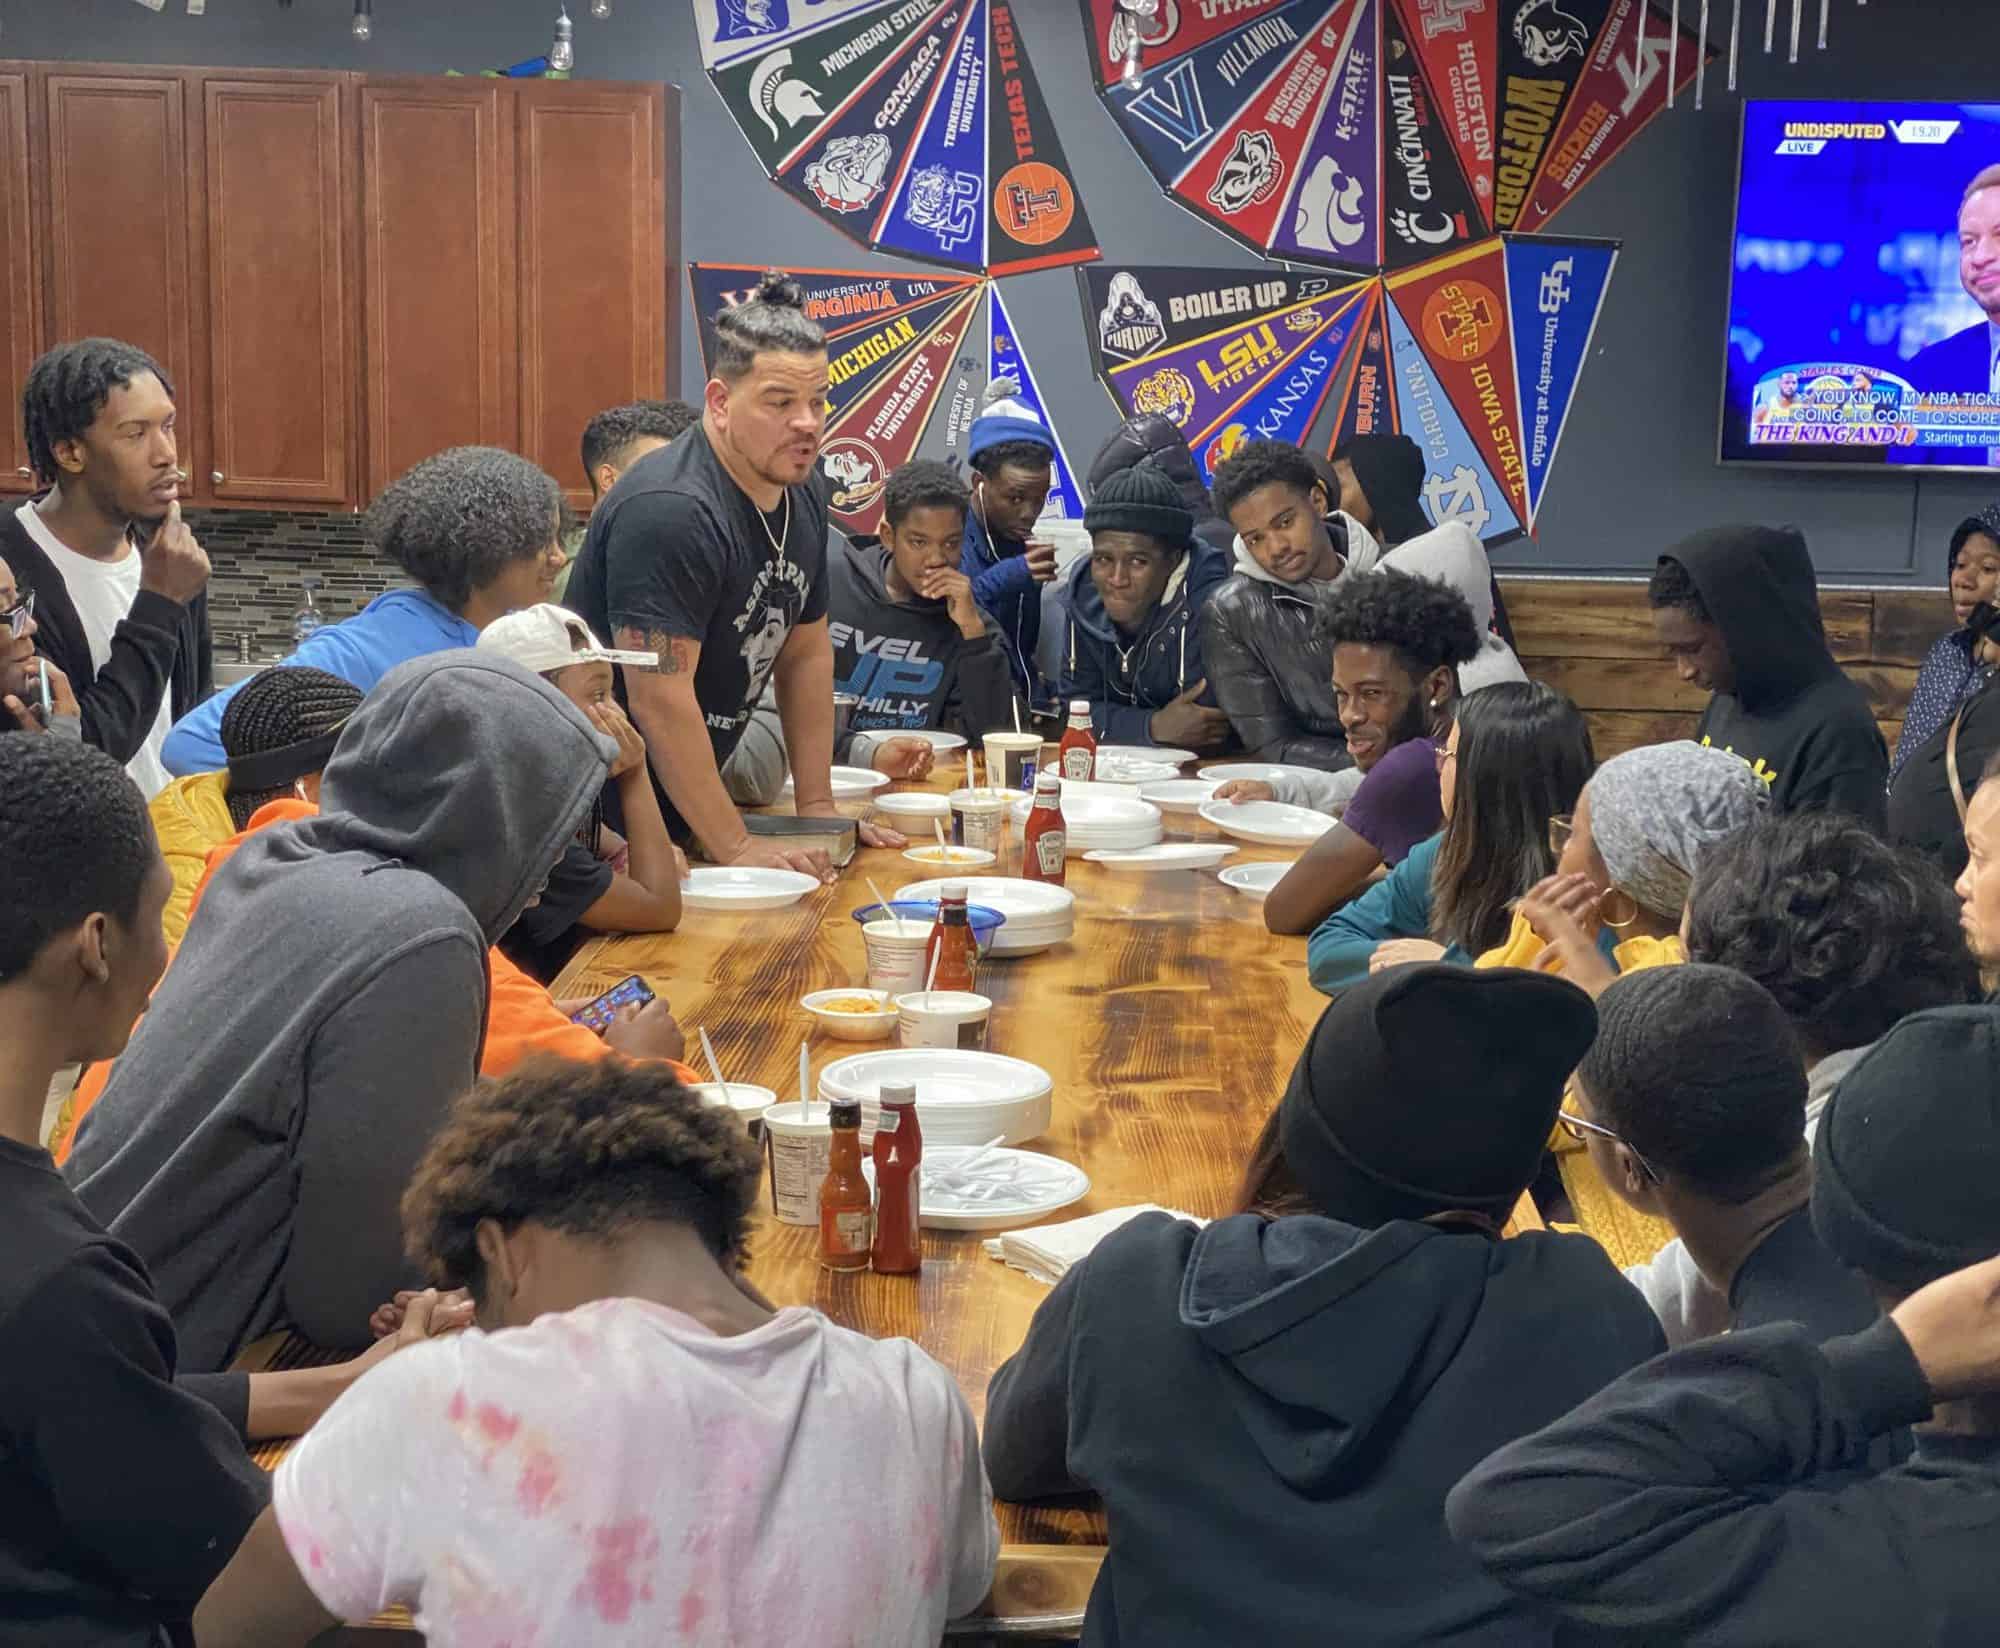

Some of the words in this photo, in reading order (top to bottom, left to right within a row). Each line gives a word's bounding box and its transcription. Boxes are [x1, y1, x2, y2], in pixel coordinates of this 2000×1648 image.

[820, 20, 895, 77] MICHIGAN
[890, 0, 937, 30] STATE
[991, 5, 1019, 76] TECH
[1216, 16, 1299, 87] VILLANOVA
[875, 34, 941, 129] GONZAGA
[889, 50, 941, 126] UNIVERSITY
[944, 78, 967, 148] TENNESSEE
[958, 35, 976, 77] STATE
[959, 56, 984, 133] UNIVERSITY
[1264, 49, 1318, 125] WISCONSIN
[1280, 65, 1328, 129] BADGERS
[1335, 47, 1366, 141] K-STATE
[1448, 66, 1471, 144] COUGARS
[1457, 40, 1493, 161] HOUSTON
[1005, 79, 1034, 161] TEXAS
[1387, 75, 1432, 201] CINCINNATI
[1495, 75, 1567, 226] WOFFORD
[1546, 101, 1609, 182] HOKIES
[1581, 113, 1620, 161] VIRGINIA
[1784, 122, 1887, 139] UNDISPUTED
[1786, 142, 1815, 153] LIVE
[1561, 161, 1587, 191] TECH
[806, 288, 899, 320] RGINIA
[807, 281, 873, 301] UNIVERSITY
[875, 279, 891, 291] OF
[907, 281, 937, 298] UVA
[1169, 284, 1253, 323] BOILER
[1255, 280, 1288, 308] UP
[1441, 285, 1479, 357] STATE
[1106, 326, 1160, 351] PURDUE
[1196, 323, 1278, 387] LSU
[1210, 347, 1286, 394] TIGERS
[1535, 317, 1560, 395] University
[866, 390, 904, 442] FLORIDA
[898, 353, 930, 392] STATE
[881, 368, 936, 441] UNIVERSITY
[946, 393, 966, 447] UNIVERSITY
[957, 377, 969, 392] OF
[1255, 350, 1329, 439] KANSAS
[1355, 365, 1377, 434] BURN
[1404, 359, 1449, 460] CAROLINA
[1470, 362, 1504, 425] IOWA
[1491, 424, 1527, 497] STATE
[1536, 394, 1549, 411] at
[1815, 391, 1845, 403] YOU
[1903, 391, 1926, 405] MY
[1928, 391, 1959, 405] NBA
[1853, 410, 1872, 422] TO
[1875, 409, 1920, 423] COME
[1925, 410, 1945, 423] TO
[1948, 411, 1998, 424] SCORE
[1532, 413, 1549, 467] Buffalo
[1756, 424, 1794, 441] THE
[1797, 424, 1848, 442] KING
[1850, 424, 1897, 442] AND
[1924, 431, 1963, 446] Starting
[1966, 431, 1977, 442] to
[829, 621, 930, 665] EVEL
